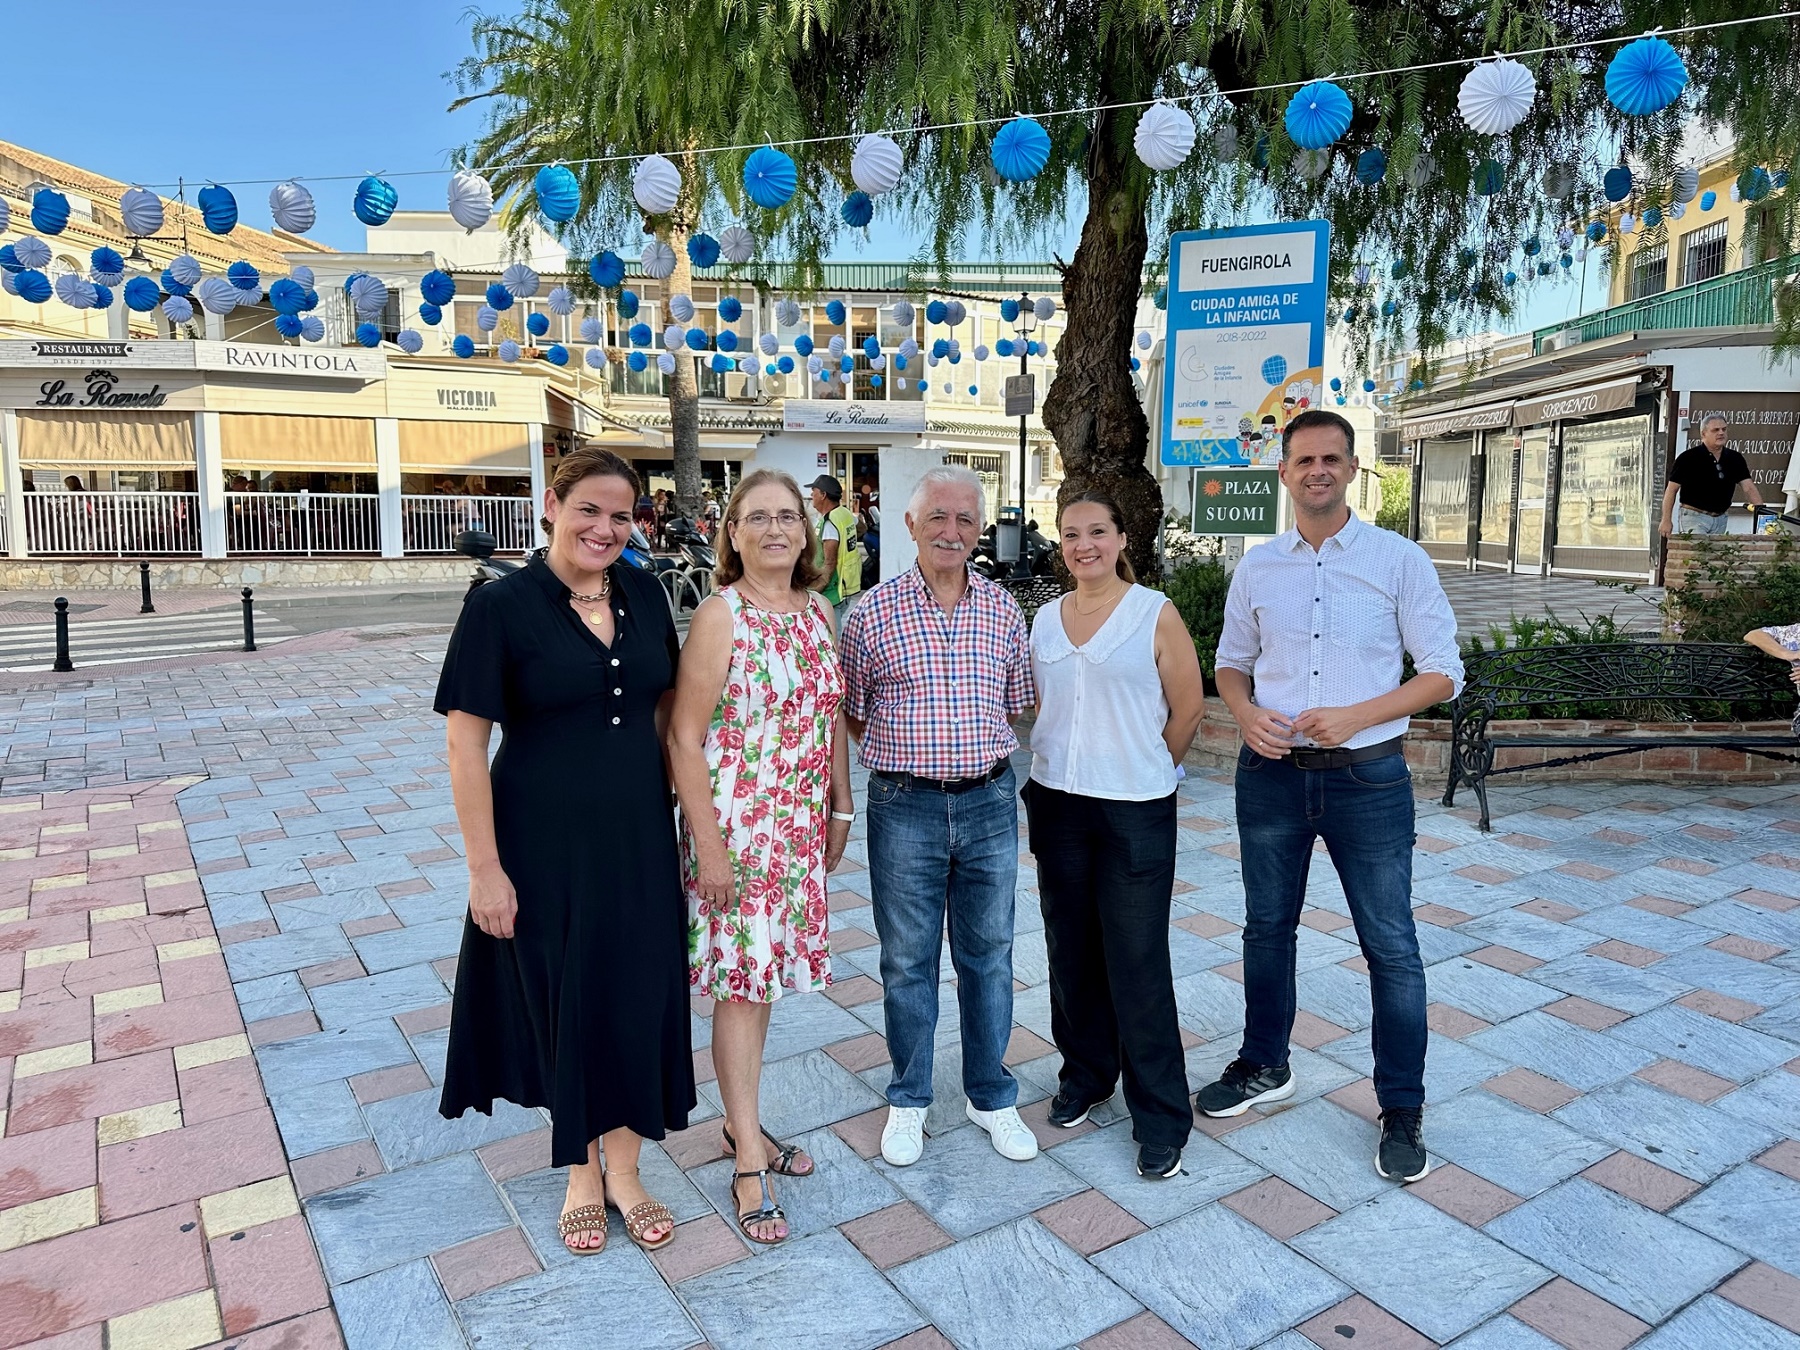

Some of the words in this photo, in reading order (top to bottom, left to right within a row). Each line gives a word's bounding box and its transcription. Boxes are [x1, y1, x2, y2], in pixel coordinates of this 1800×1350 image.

[1201, 253, 1292, 274] FUENGIROLA
[1191, 296, 1235, 311] CIUDAD
[1238, 294, 1279, 308] AMIGA
[1283, 293, 1299, 305] DE
[1206, 312, 1221, 324] LA
[1224, 308, 1281, 323] INFANCIA
[1216, 331, 1267, 343] 2018-2022
[43, 344, 122, 354] RESTAURANTE
[226, 347, 358, 372] RAVINTOLA
[36, 379, 74, 406] La
[79, 380, 168, 408] Rozuela
[437, 388, 497, 407] VICTORIA
[1178, 400, 1200, 408] unicef
[1540, 392, 1598, 419] SORRENTO
[823, 411, 842, 424] La
[845, 411, 889, 425] Rozuela
[1402, 425, 1417, 438] BAR
[1467, 409, 1509, 427] PIZZERIA
[1691, 410, 1703, 424] LA
[1735, 408, 1756, 425] ESTÁ
[1757, 411, 1793, 425] ABIERTA
[1741, 440, 1771, 454] AUKI
[1771, 440, 1795, 454] KOK
[1753, 470, 1764, 484] IS
[1765, 470, 1787, 484] OPE
[1224, 481, 1272, 495] PLAZA
[1206, 506, 1265, 521] SUOMI
